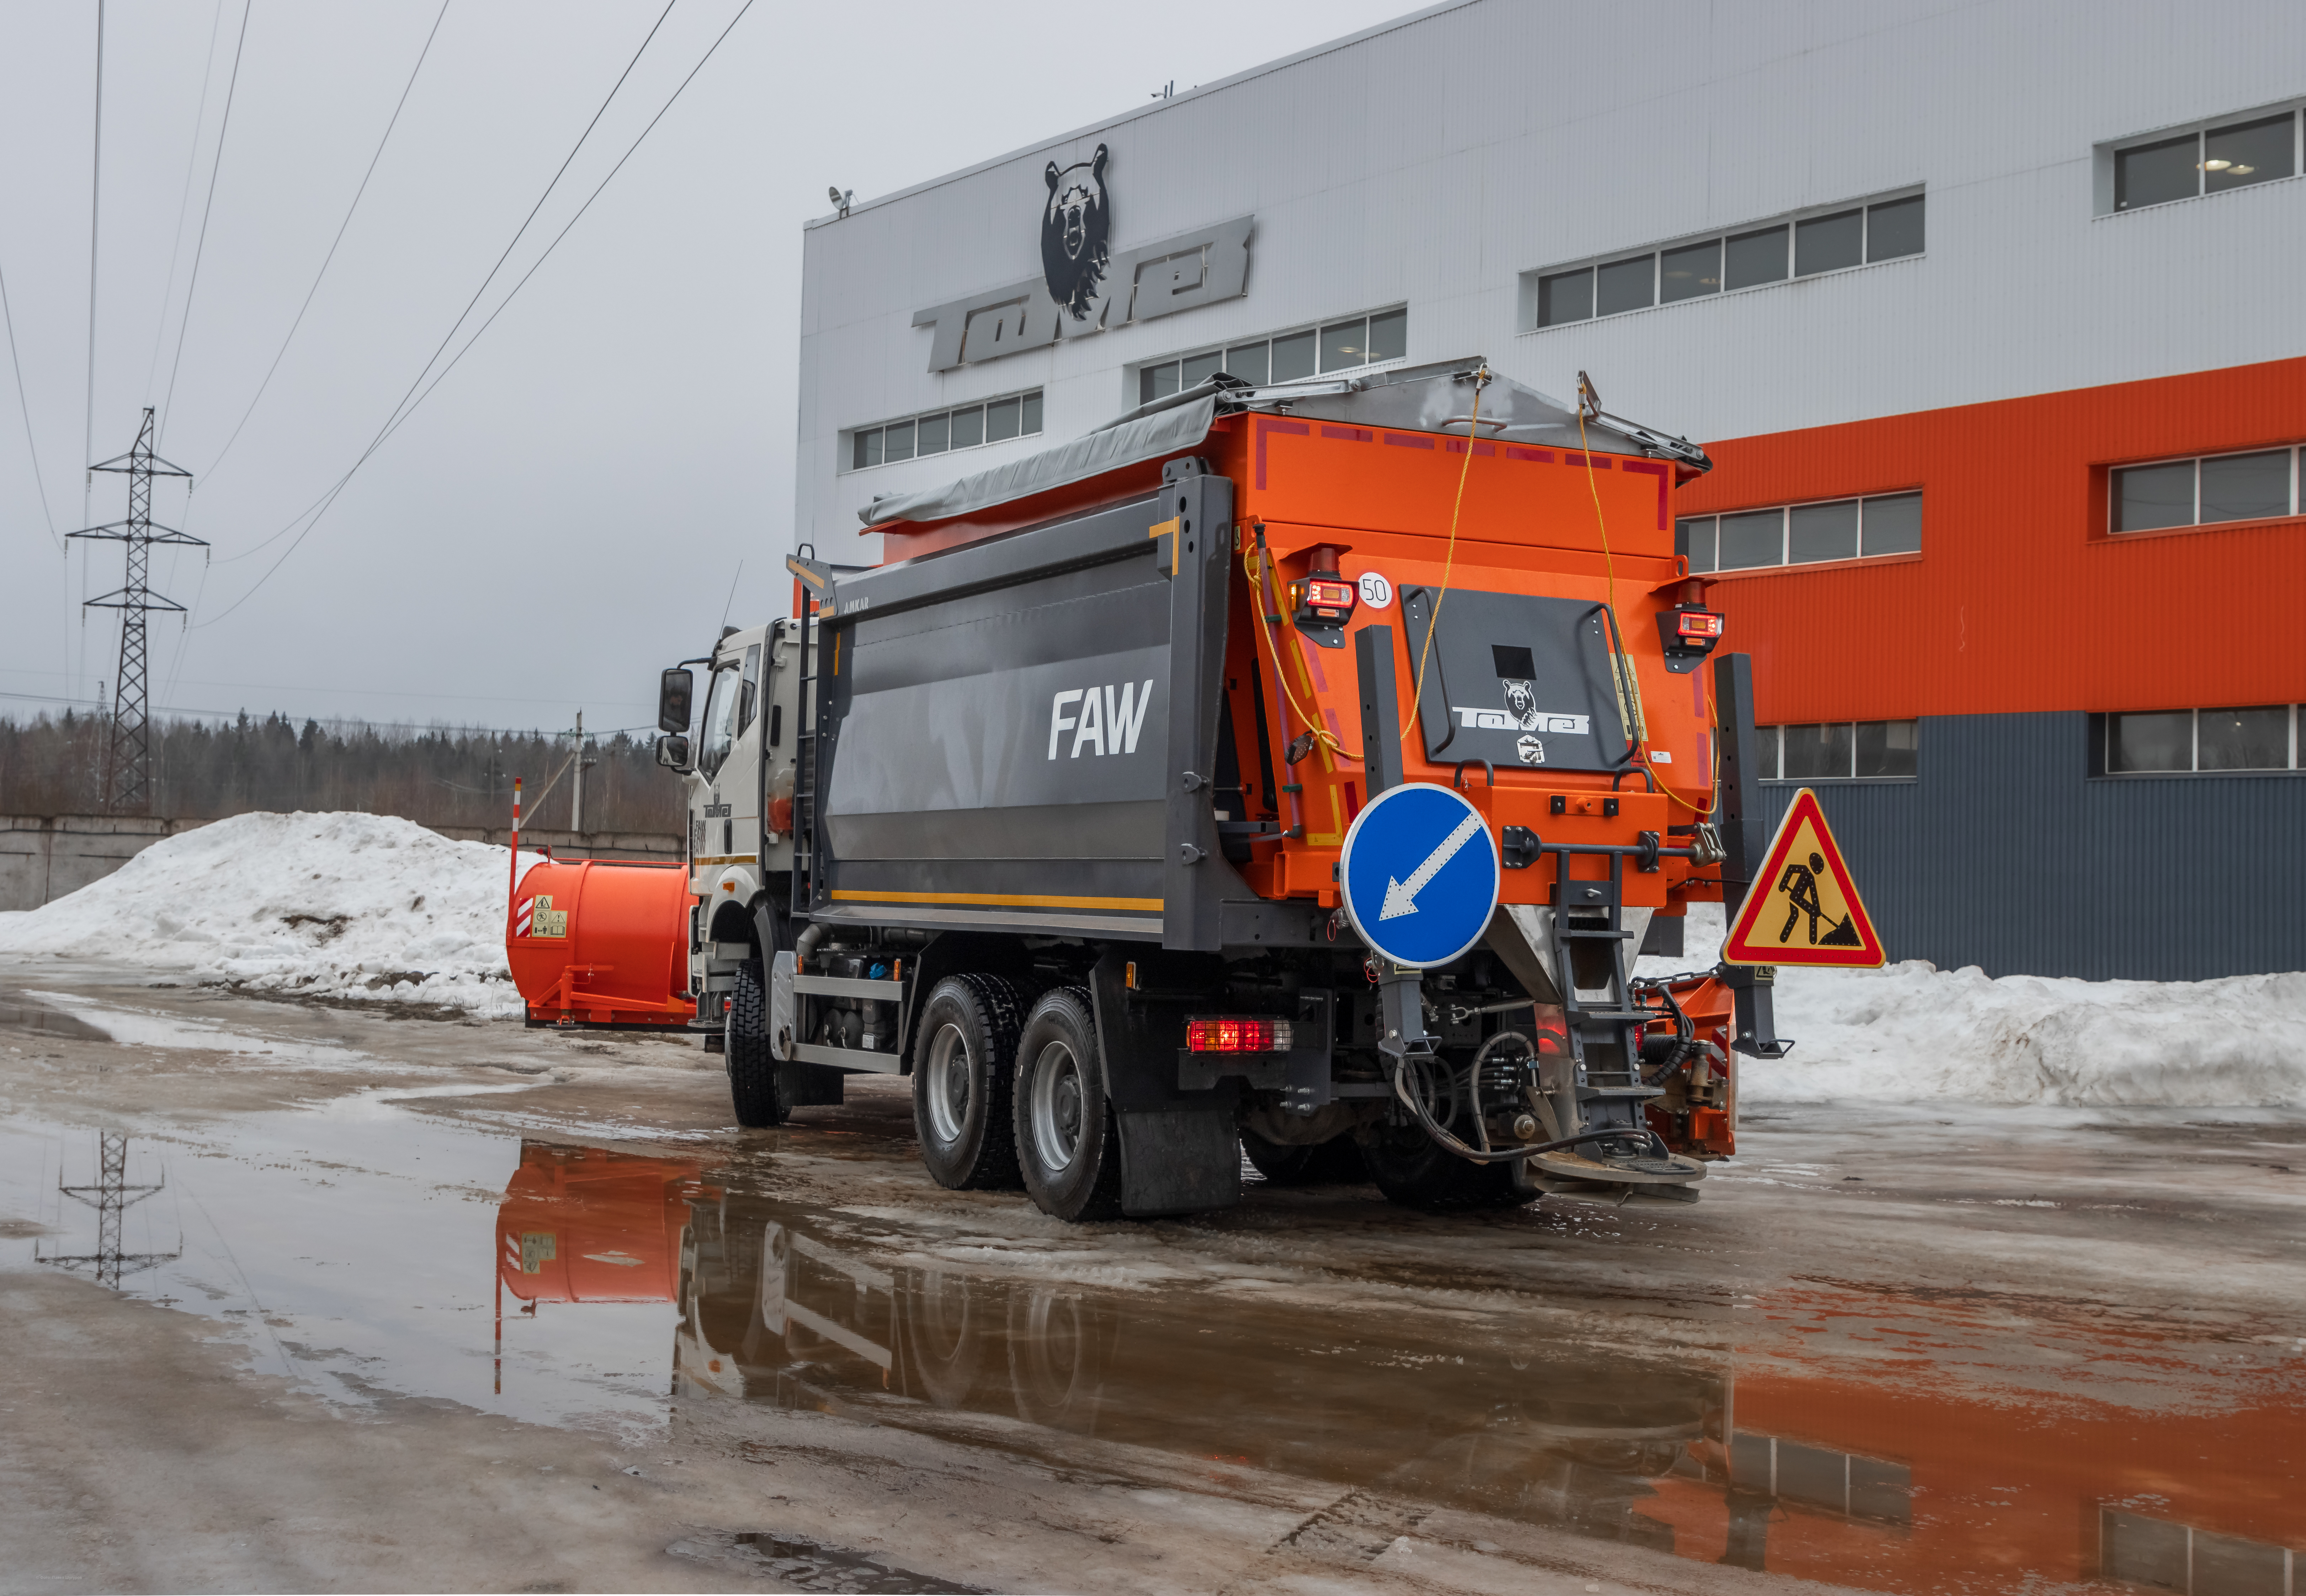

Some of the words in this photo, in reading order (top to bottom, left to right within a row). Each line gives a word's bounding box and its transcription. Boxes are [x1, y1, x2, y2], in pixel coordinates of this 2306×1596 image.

[1363, 579, 1386, 601] 50
[844, 597, 868, 615] AMKAR
[1048, 679, 1153, 760] FAW
